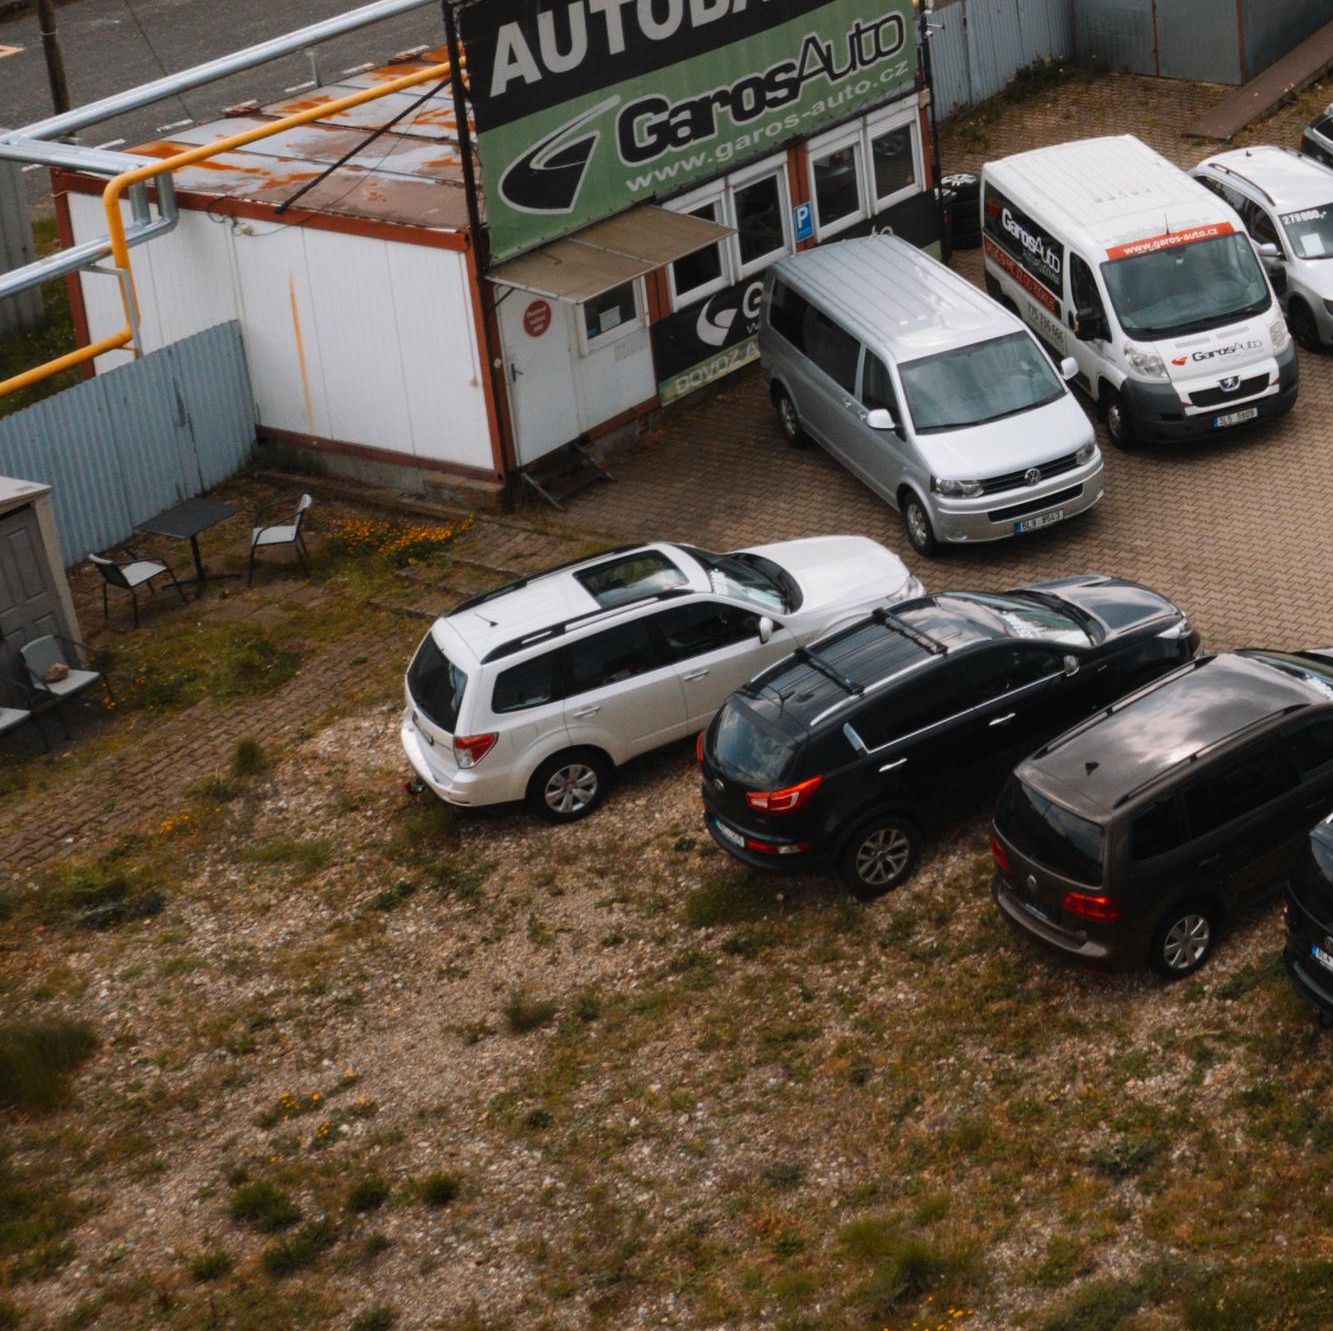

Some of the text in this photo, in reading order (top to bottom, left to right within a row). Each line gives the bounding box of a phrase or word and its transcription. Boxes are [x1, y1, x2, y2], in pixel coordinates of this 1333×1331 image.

[615, 11, 906, 166] GarosAuto
[626, 60, 909, 192] www.garos-auto.cz
[1001, 208, 1061, 274] GarosAuto
[1123, 227, 1219, 256] www.garos-auto.cz
[675, 352, 740, 394] DOVOZ
[1191, 338, 1263, 362] GarosAuto
